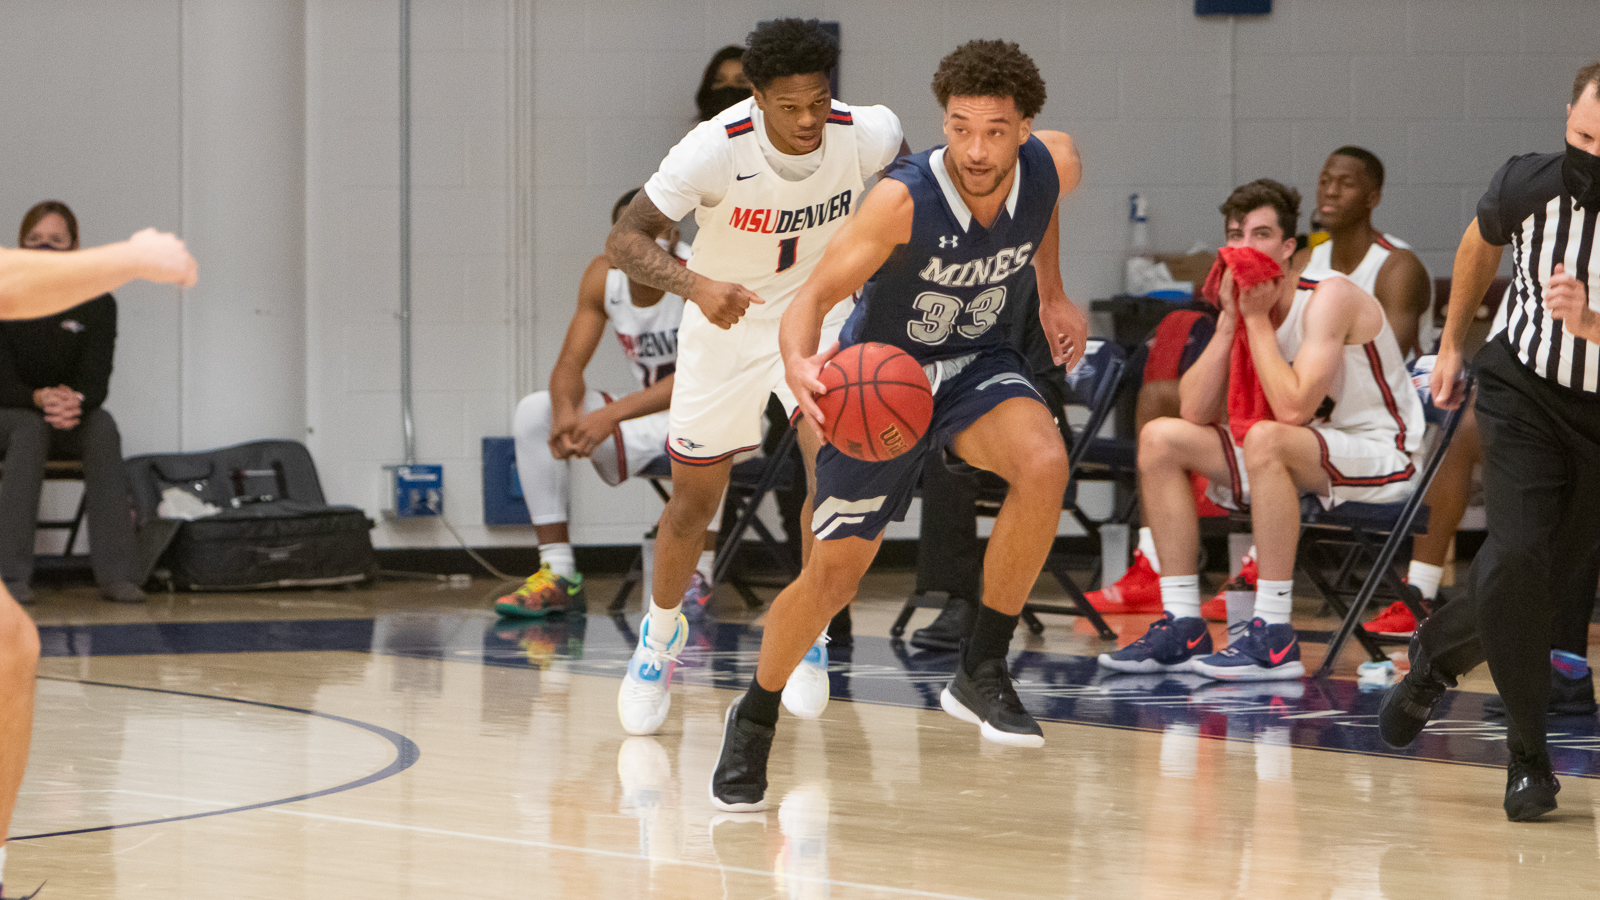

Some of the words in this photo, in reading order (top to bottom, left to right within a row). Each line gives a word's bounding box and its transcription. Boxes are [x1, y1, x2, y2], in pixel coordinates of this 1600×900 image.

[775, 235, 800, 274] 1
[918, 241, 1033, 288] MINES
[906, 285, 1007, 346] 33
